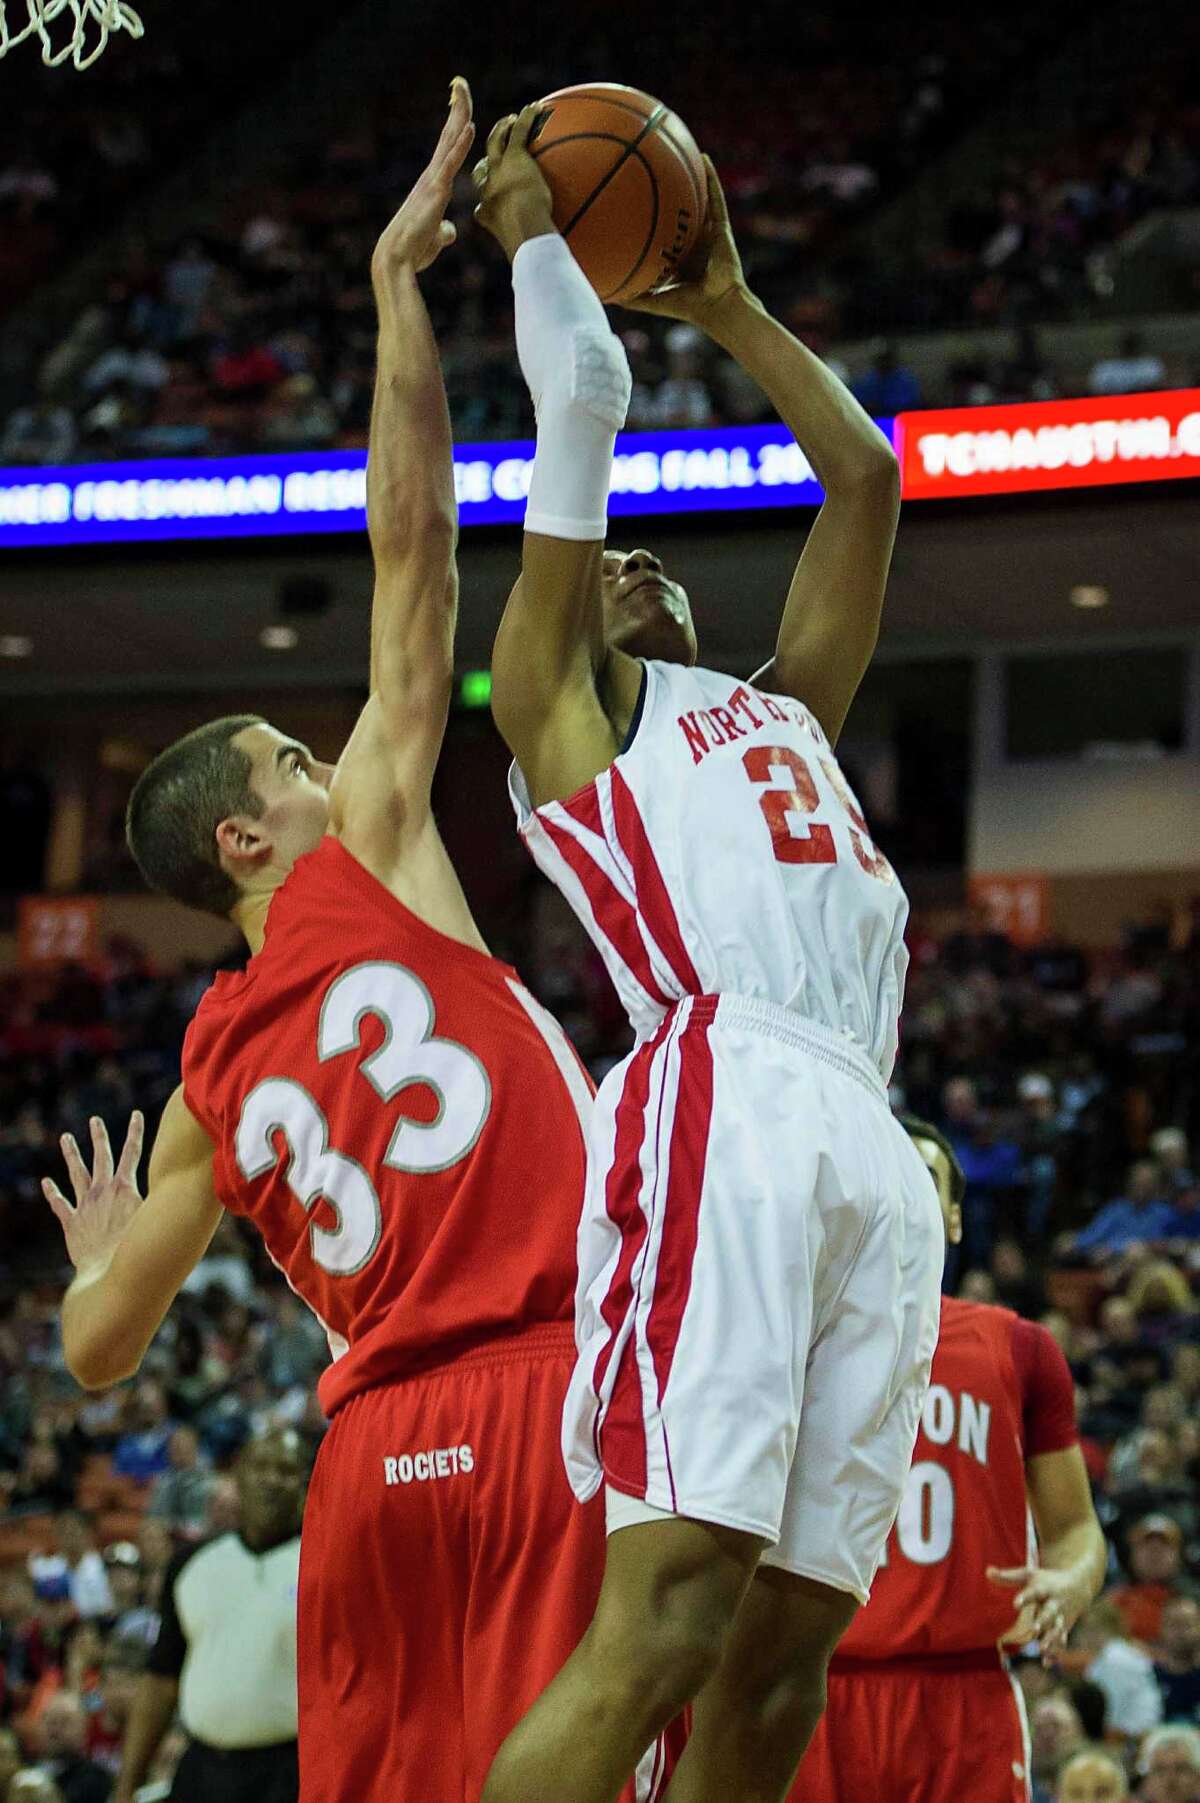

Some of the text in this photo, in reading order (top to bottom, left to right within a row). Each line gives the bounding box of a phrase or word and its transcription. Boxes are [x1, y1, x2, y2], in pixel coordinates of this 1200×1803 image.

[235, 960, 493, 1277] 33
[383, 1443, 474, 1486] ROCKETS
[878, 1460, 956, 1567] 0
